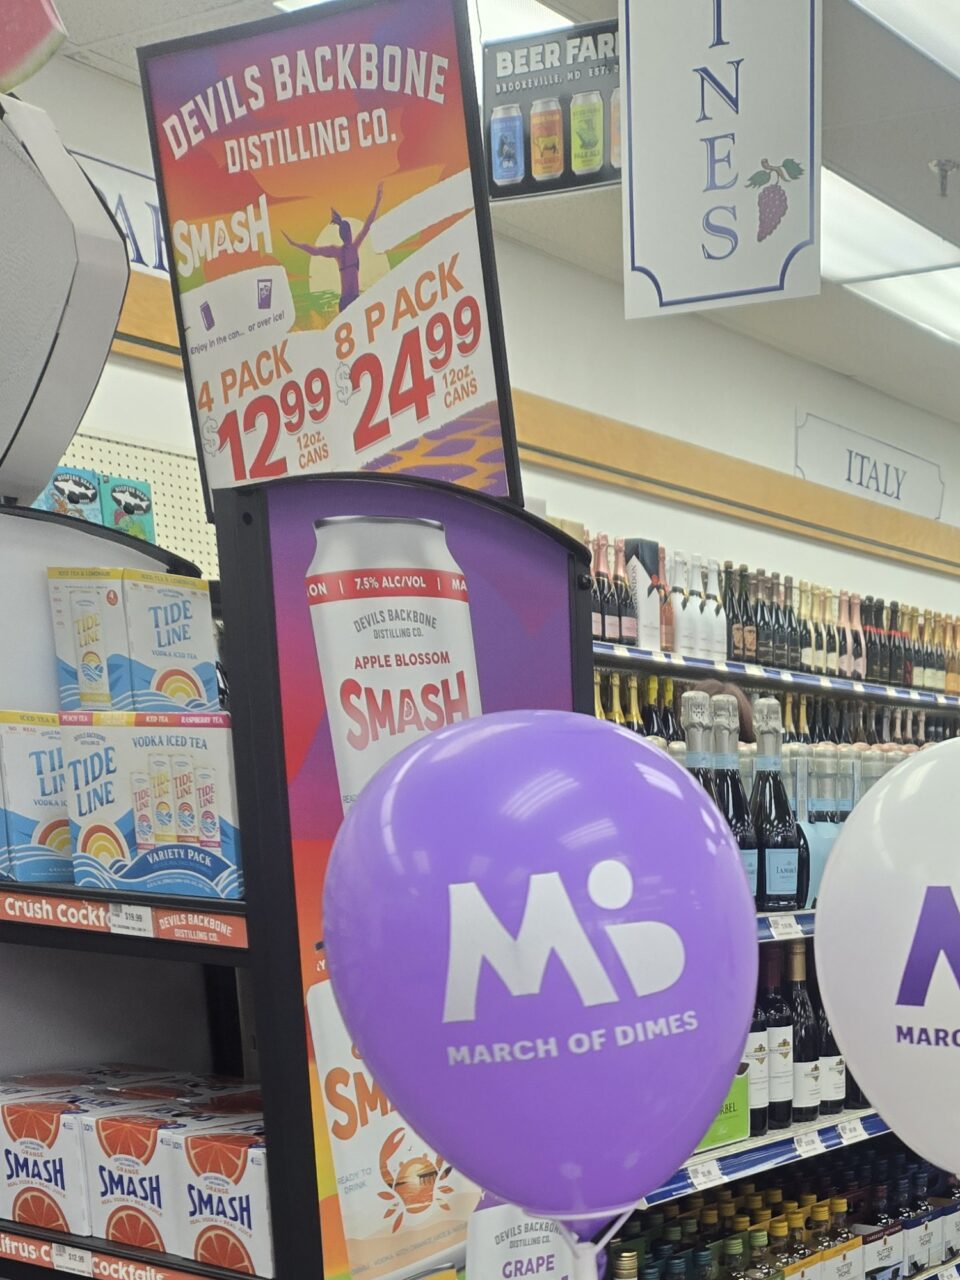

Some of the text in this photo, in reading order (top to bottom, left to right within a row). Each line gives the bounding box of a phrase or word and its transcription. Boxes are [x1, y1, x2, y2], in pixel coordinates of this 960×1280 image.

[496, 32, 618, 77] BEER FAR
[162, 42, 449, 161] DEVILS BACKBONE
[224, 107, 397, 174] DISTILLING CO.
[172, 194, 273, 278] SMASH
[334, 252, 465, 360] 8 PACK
[190, 343, 208, 355] Enjoy
[216, 335, 227, 345] the
[248, 323, 255, 332] or
[257, 317, 271, 328] over
[197, 339, 293, 413] 4 PACK
[442, 367, 474, 389] 12oz.
[443, 378, 479, 410] CANS
[296, 431, 326, 453] 12oz.
[298, 443, 330, 470] CANS
[845, 449, 908, 502] ITALY
[354, 576, 426, 591] 7.5% ALC/VOL
[148, 600, 193, 629] TIDE
[353, 609, 437, 633] DEVILS BACKBONE
[156, 624, 192, 648] LINE
[354, 651, 450, 670] APPLE BLOSSOM
[339, 670, 470, 751] SMASH
[132, 736, 208, 750] VODKA ICED TEA
[68, 746, 117, 791] TIDE
[76, 781, 115, 818] LINE
[147, 848, 212, 867] VARIETY PACK
[4, 895, 52, 919] Crush
[159, 914, 232, 936] DEVILS BACKBONE
[447, 1011, 698, 1066] MARCH OF DIMES
[4, 1148, 66, 1191] SMASH
[187, 1184, 253, 1230] SMASH
[503, 1255, 555, 1279] GRAPE
